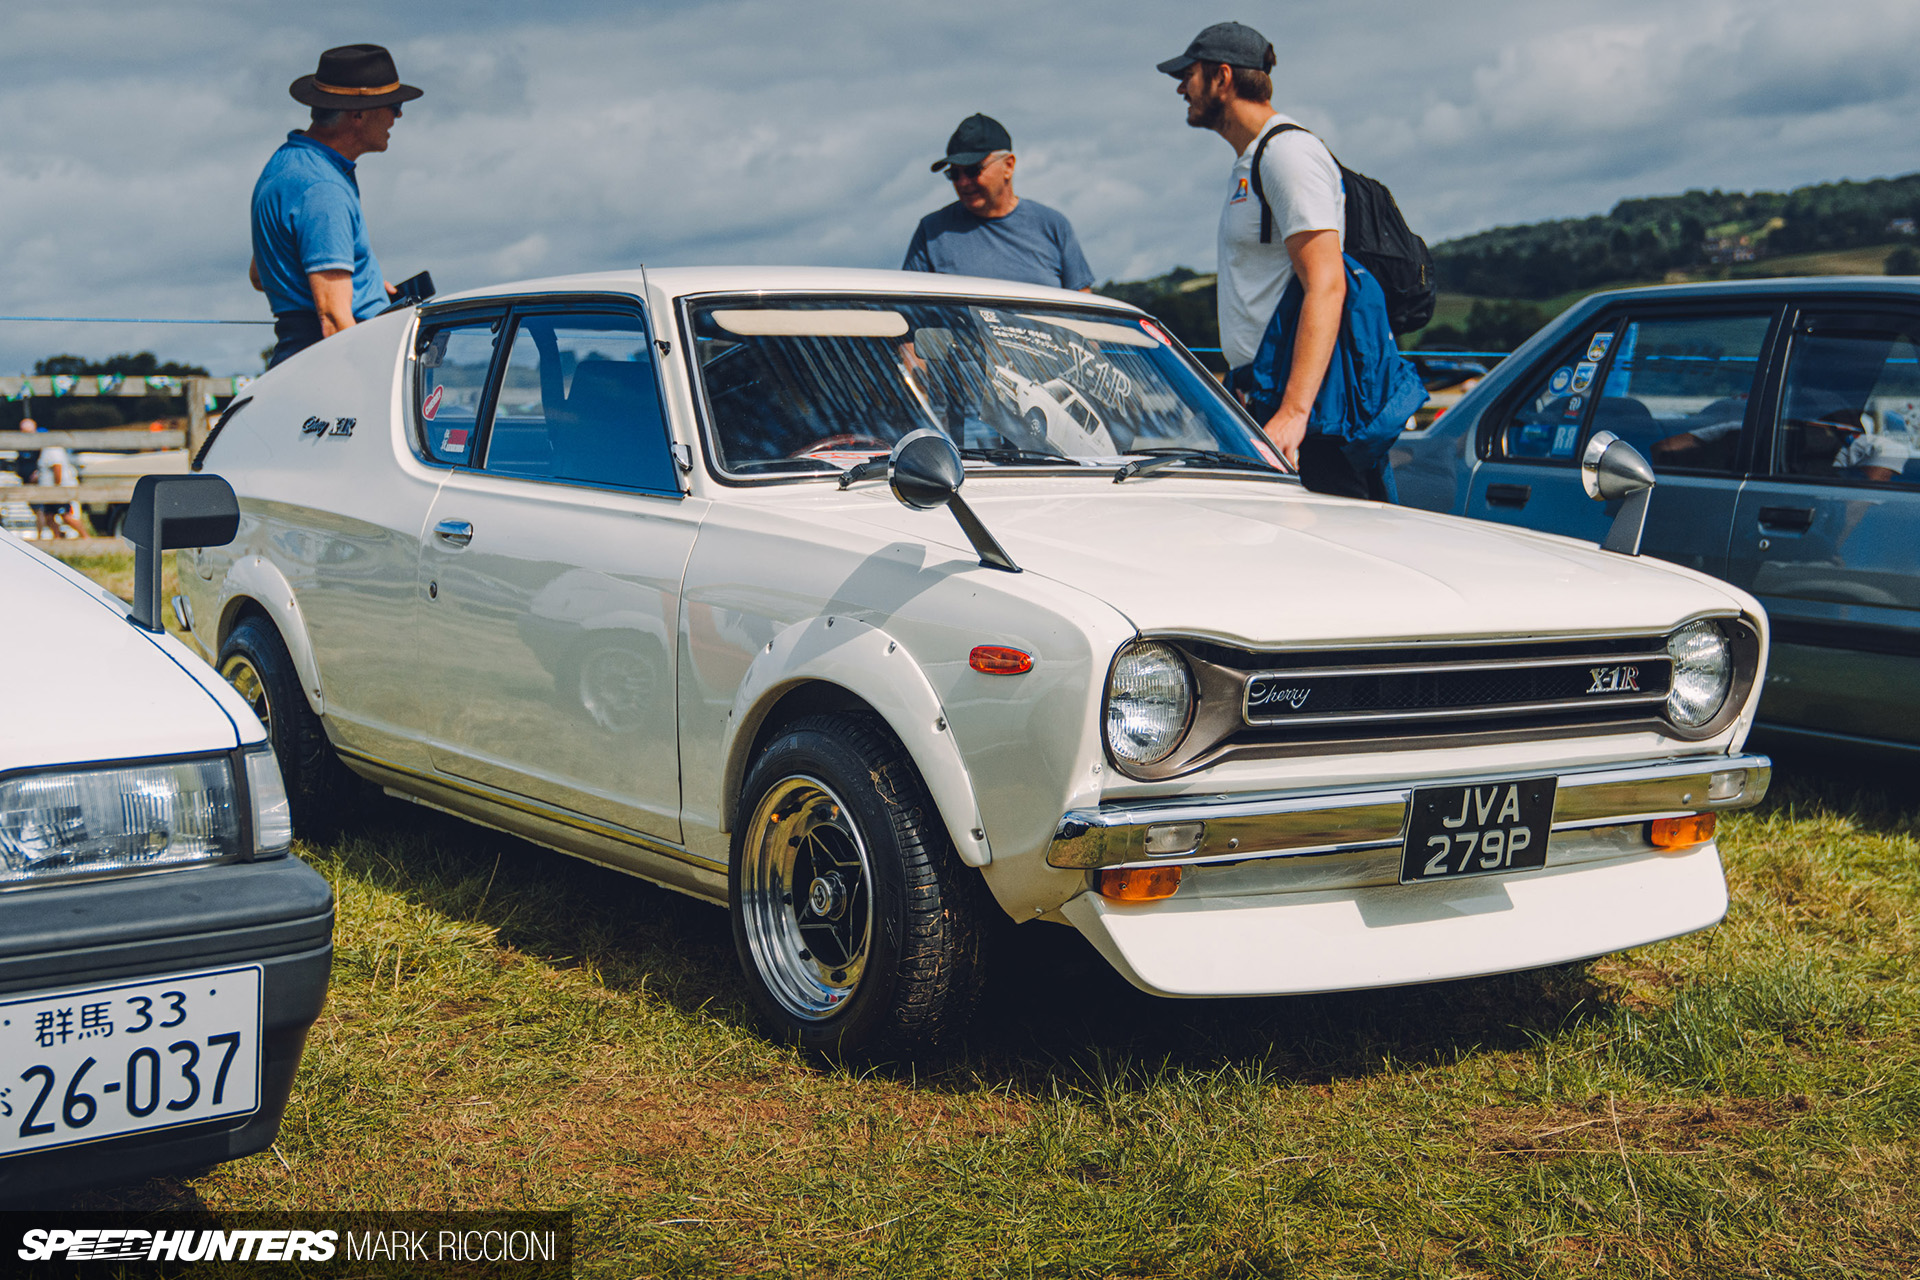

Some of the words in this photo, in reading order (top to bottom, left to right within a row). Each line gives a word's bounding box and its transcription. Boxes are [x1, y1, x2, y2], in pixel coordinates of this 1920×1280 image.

[1247, 682, 1311, 709] Cherry
[1586, 666, 1640, 693] X-1R
[1442, 784, 1520, 828] JVA
[1423, 826, 1532, 875] 279P
[35, 1001, 114, 1048] 群馬
[125, 991, 187, 1033] 33
[19, 1031, 241, 1138] 26-037
